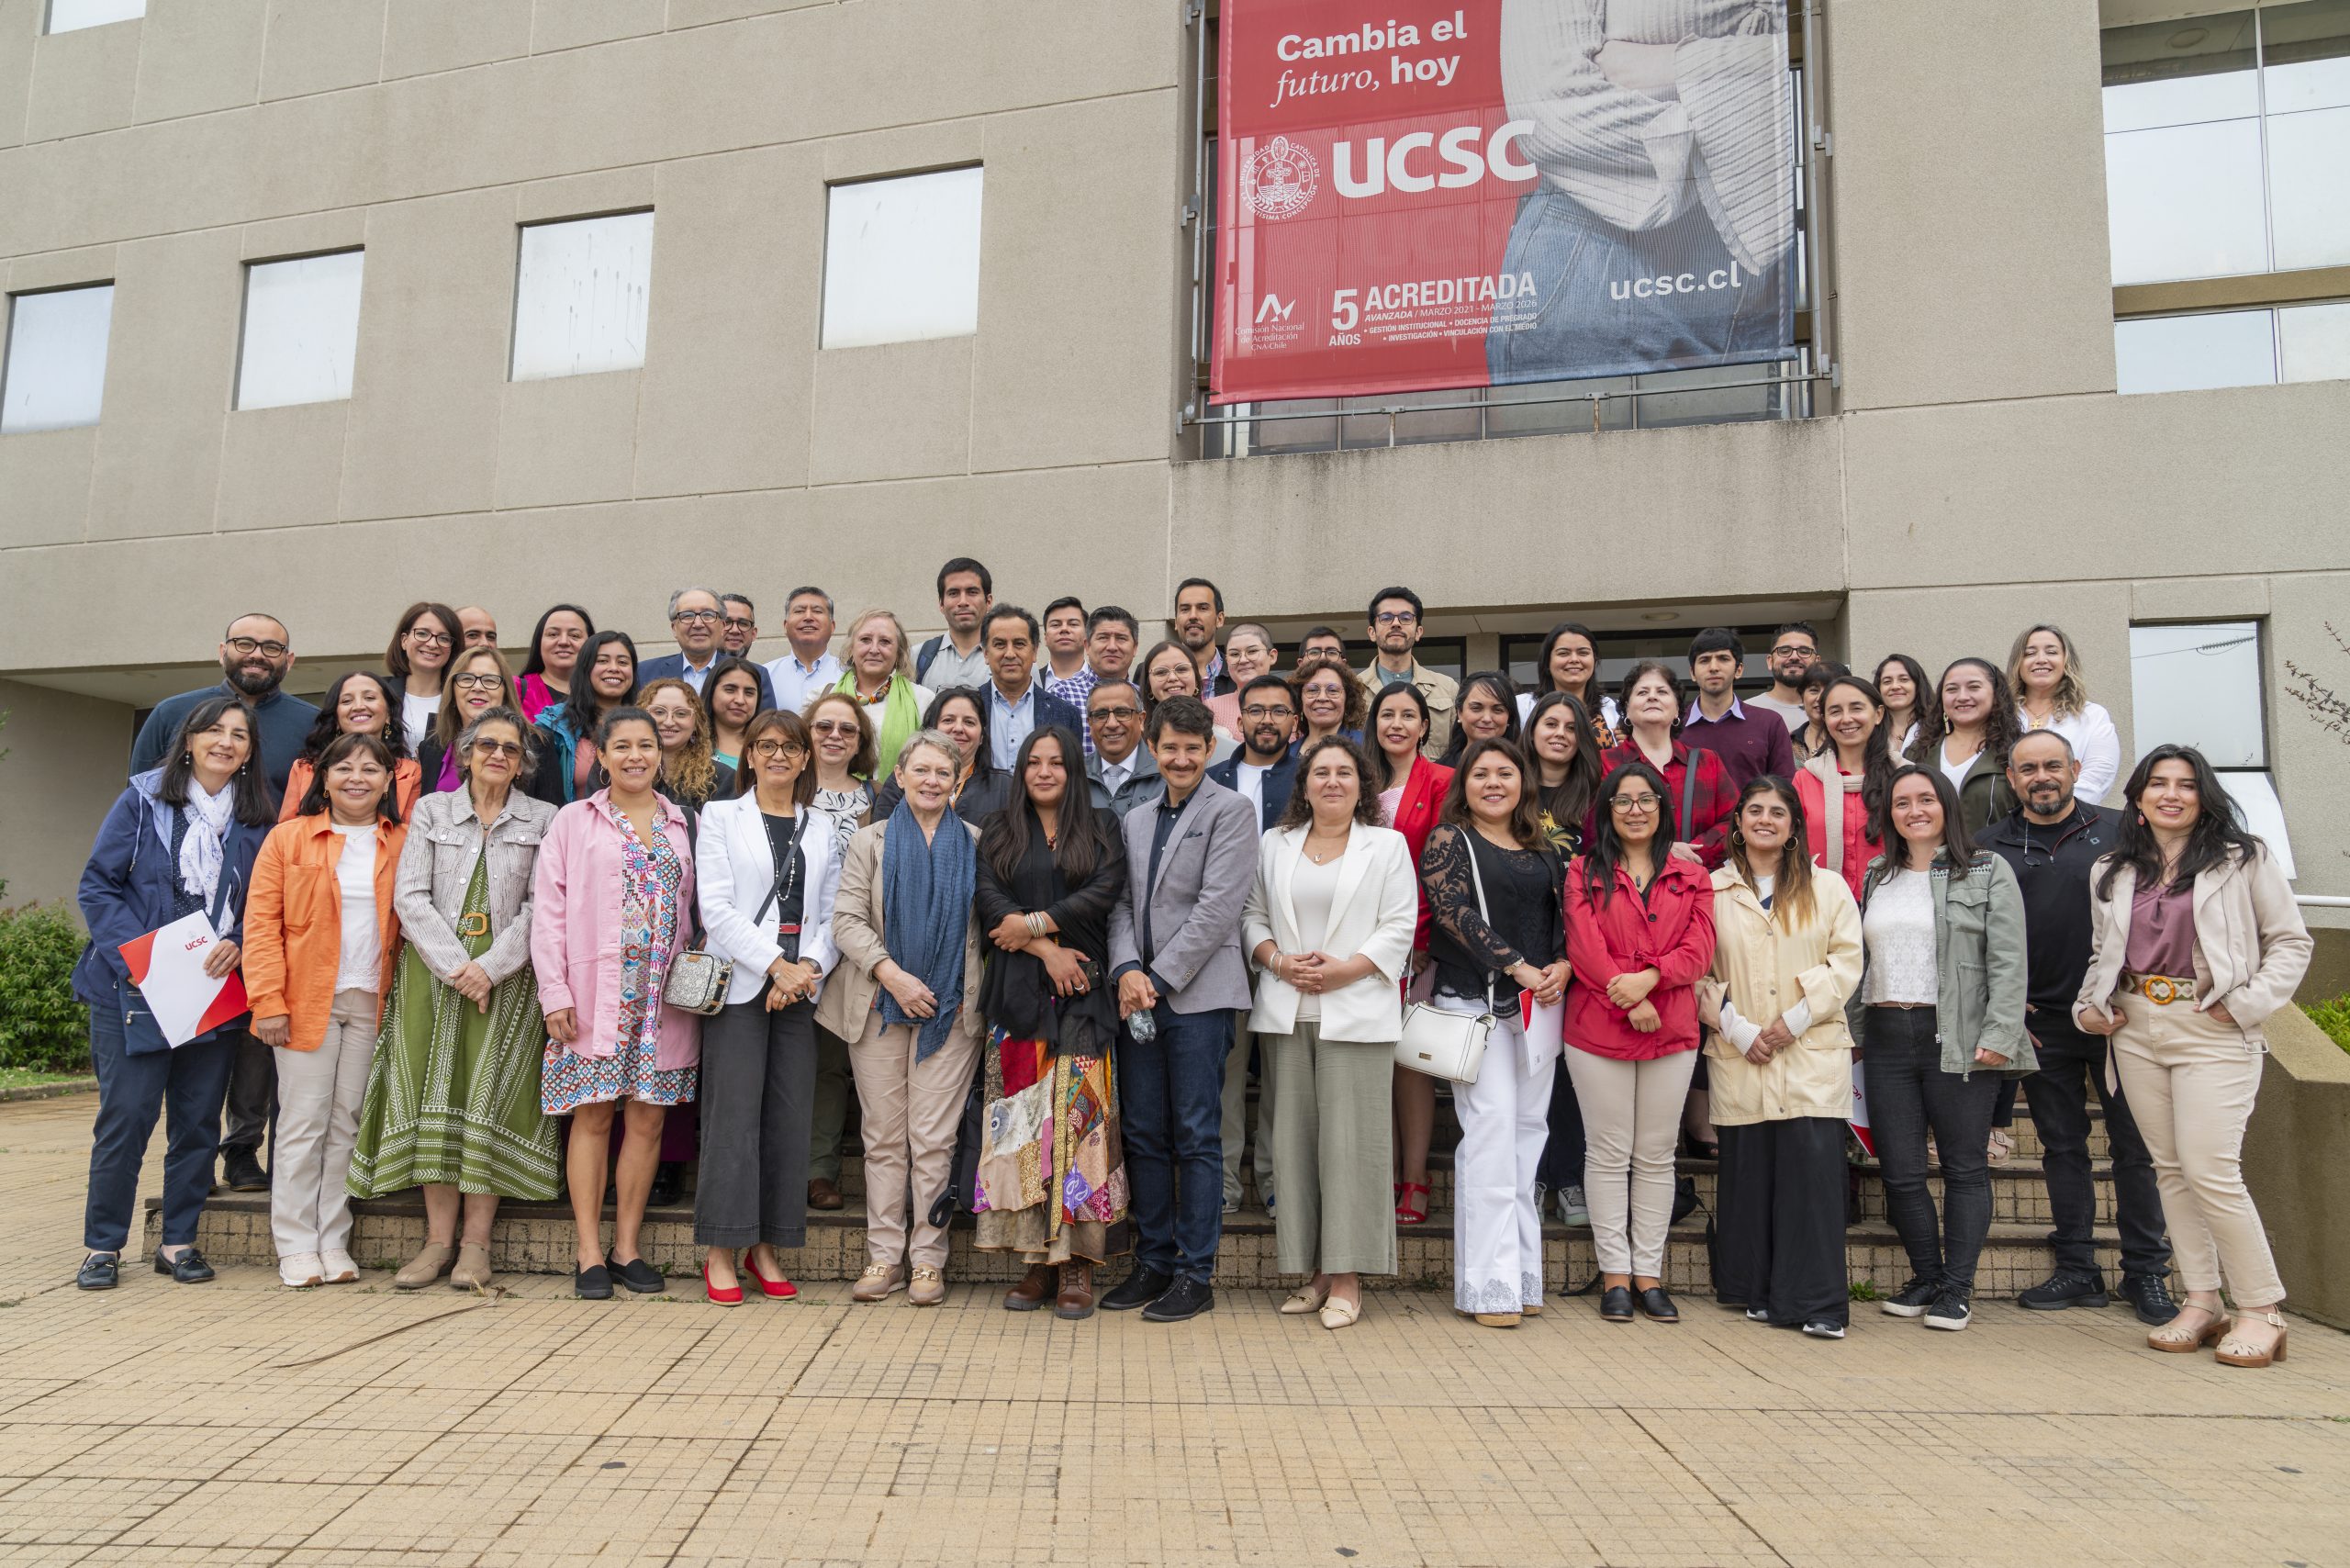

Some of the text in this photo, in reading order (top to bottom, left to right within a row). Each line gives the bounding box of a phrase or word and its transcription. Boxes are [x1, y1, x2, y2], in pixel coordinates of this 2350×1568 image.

[1277, 10, 1467, 62] Cambia el
[1270, 56, 1460, 108] futuro, hoy
[1333, 119, 1538, 198] UCSC
[1611, 260, 1741, 300] ucsc.cl
[1332, 272, 1537, 330] 5 ACREDITADA
[1365, 310, 1413, 322] AVANZADA
[1420, 307, 1452, 317] MARZO
[1454, 305, 1473, 314] 2021
[1482, 302, 1513, 312] MARZO
[1516, 300, 1537, 308] 2026
[1272, 321, 1304, 331] Nacional
[1369, 324, 1397, 334] GESTIÓN
[1399, 321, 1447, 331] INSTITUCIONAL
[1455, 317, 1488, 326] DOCENCIA
[1500, 313, 1537, 322] PREGRADO
[1388, 330, 1438, 341] INVESTIGACIÓN
[1444, 326, 1488, 336] VINCULACIÓN
[1514, 322, 1537, 331] MEDIO
[1253, 332, 1298, 342] Acreditación
[1329, 333, 1361, 347] AÑOS
[185, 936, 208, 951] UCSC
